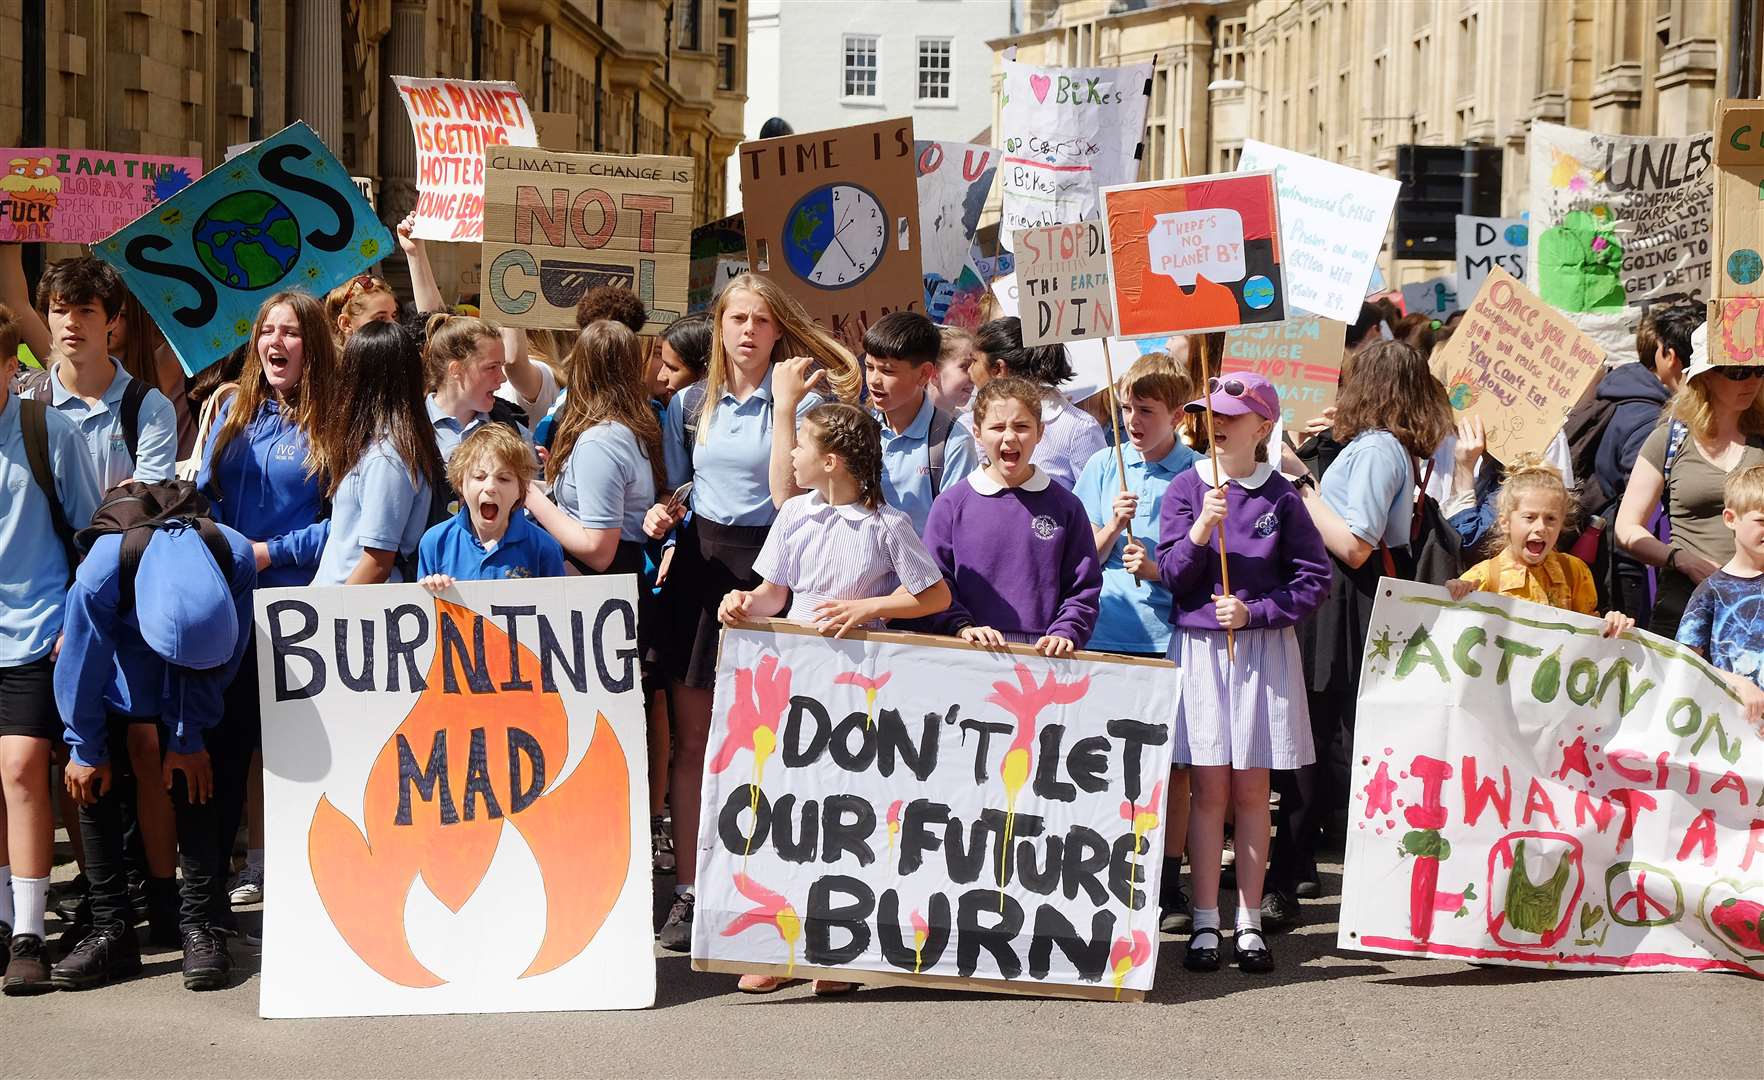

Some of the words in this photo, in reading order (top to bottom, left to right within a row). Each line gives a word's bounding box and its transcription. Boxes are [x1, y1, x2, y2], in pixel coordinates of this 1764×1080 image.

[400, 84, 450, 118] THIS
[444, 83, 525, 128] PLANET
[415, 122, 434, 152] IS
[434, 123, 510, 156] GETTING
[742, 138, 841, 181] TIME
[873, 127, 910, 160] IS
[56, 154, 71, 173] I
[75, 156, 116, 177] AM
[420, 155, 484, 186] HOTTER
[492, 156, 577, 174] CLIMATE
[589, 163, 662, 181] CHANGE
[673, 170, 689, 183] IS
[63, 177, 136, 200] LORAX
[0, 200, 51, 223] FUCK
[55, 199, 96, 215] SPEAK
[102, 201, 124, 215] FOR
[416, 191, 457, 220] YOUNG
[515, 185, 674, 253] NOT
[1181, 235, 1202, 248] NO
[1691, 218, 1709, 236] IS
[1023, 223, 1085, 265] STOP
[1161, 246, 1209, 271] PLANET
[1622, 246, 1678, 272] GOING
[1684, 239, 1709, 259] TO
[1027, 279, 1058, 298] THE
[1625, 274, 1657, 294] GET
[1489, 280, 1539, 327] Once
[1535, 319, 1567, 348] you
[1257, 358, 1305, 379] NOT
[266, 598, 639, 702] BURNING
[1666, 696, 1743, 765] ON
[782, 694, 1015, 786] DON'T
[1032, 718, 1168, 802] LET
[393, 726, 546, 826] MAD
[1404, 754, 1453, 830] I
[1461, 755, 1658, 856] WANT
[1677, 808, 1718, 866] A
[718, 784, 878, 867] OUR
[898, 798, 1150, 911] FUTURE
[803, 874, 1118, 983] BURN
